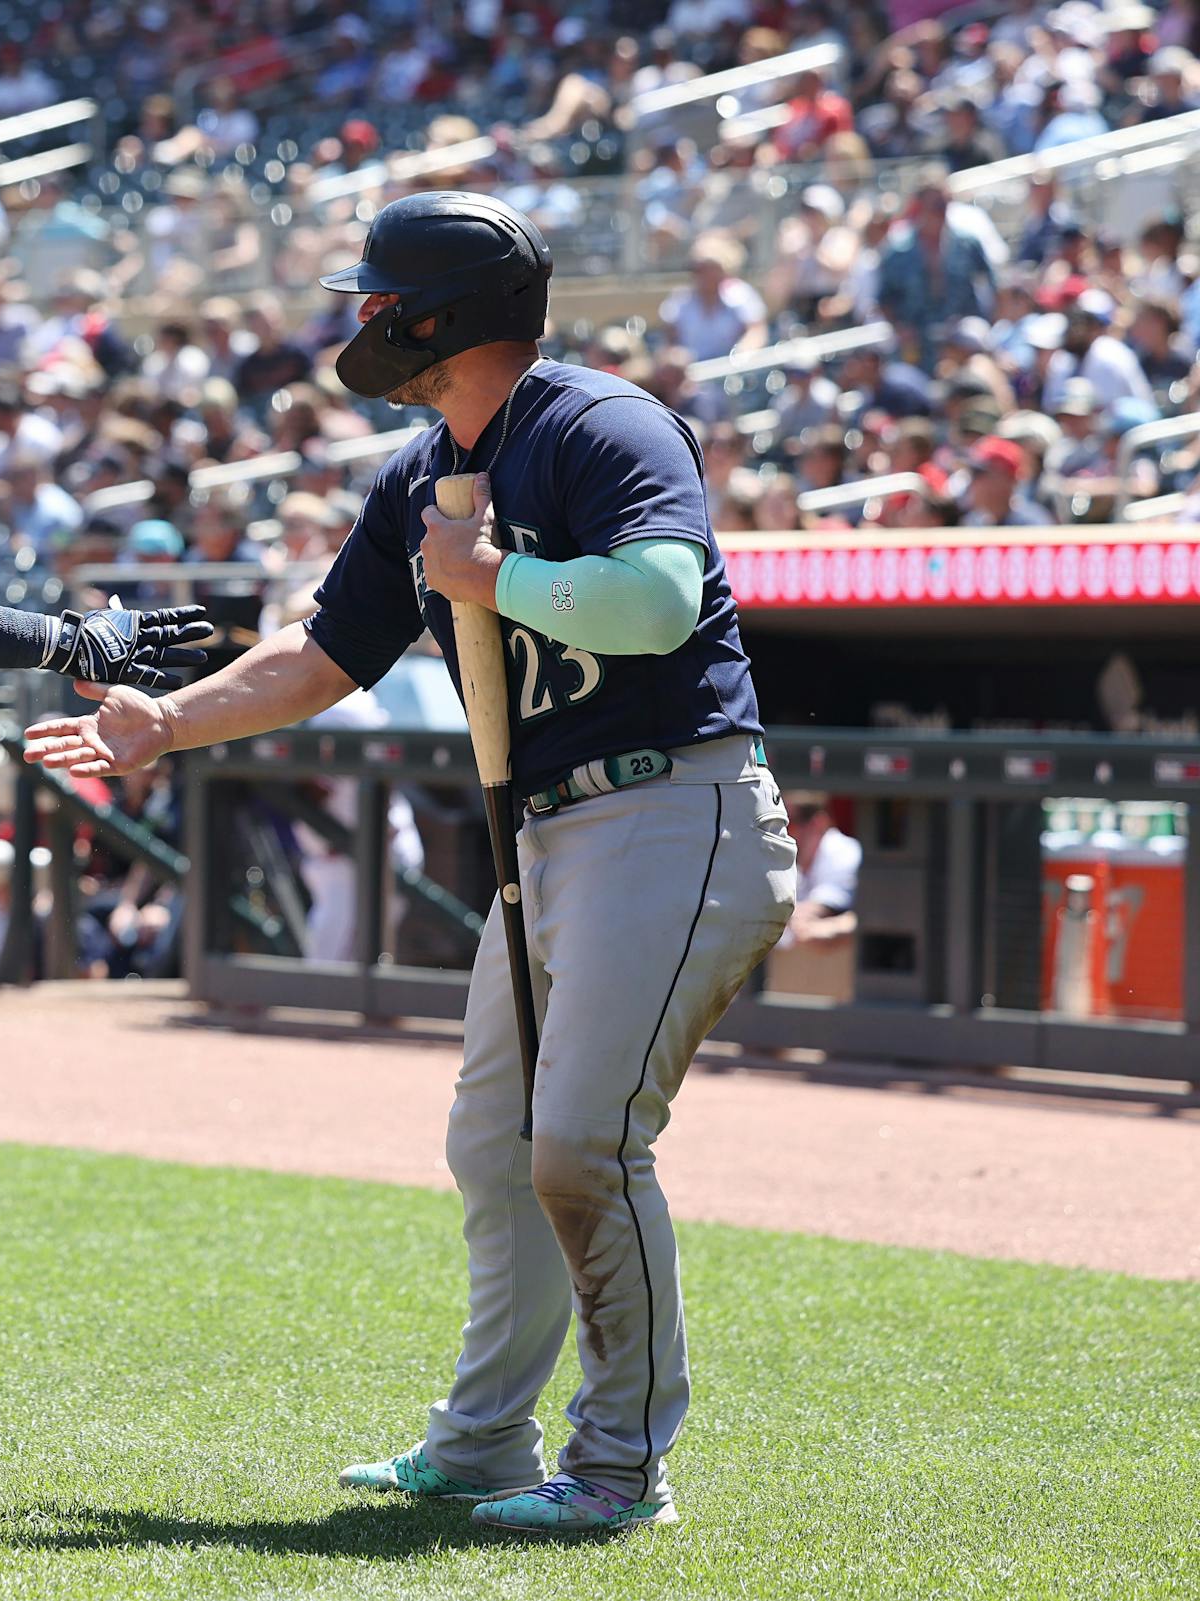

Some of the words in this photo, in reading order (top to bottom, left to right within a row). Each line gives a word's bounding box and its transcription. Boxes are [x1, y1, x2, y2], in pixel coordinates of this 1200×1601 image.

[552, 580, 574, 611] 23
[508, 628, 602, 720] 23
[630, 756, 654, 776] 23
